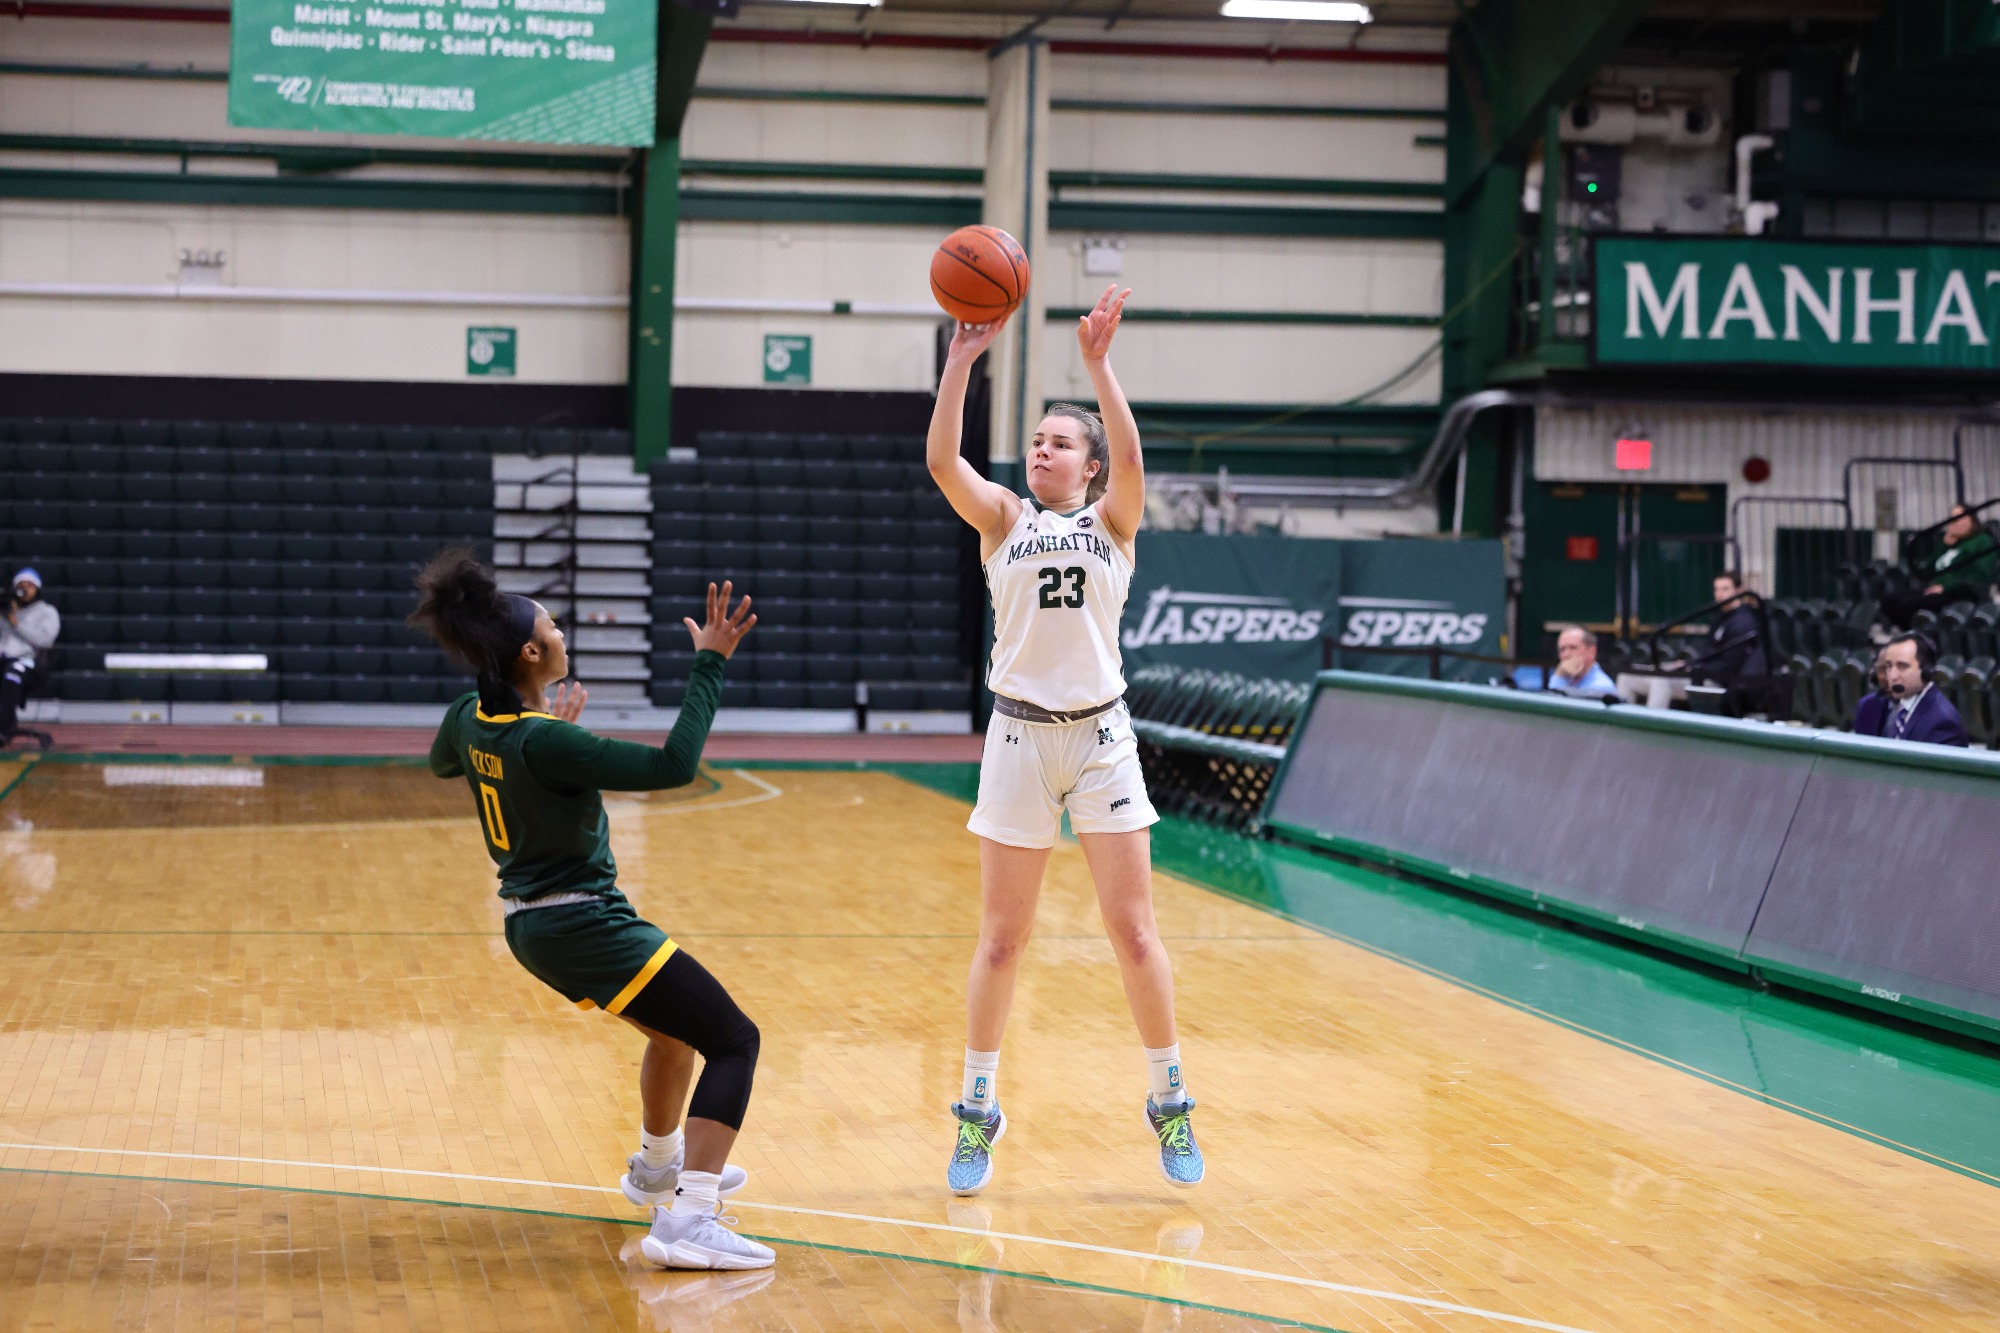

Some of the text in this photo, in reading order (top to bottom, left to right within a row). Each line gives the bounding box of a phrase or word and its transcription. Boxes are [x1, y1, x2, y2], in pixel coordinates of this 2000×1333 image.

[294, 4, 595, 40] Marist Mount St. Mary's Niagara
[270, 26, 615, 62] Quinnipiac Rider Saint Peter's Siena
[1624, 262, 2000, 346] MANHA
[1007, 533, 1112, 567] MANHATTAN
[1038, 566, 1087, 609] 23
[1123, 586, 1324, 649] JASPERS
[468, 744, 504, 781] CKSON
[479, 782, 511, 851] 0
